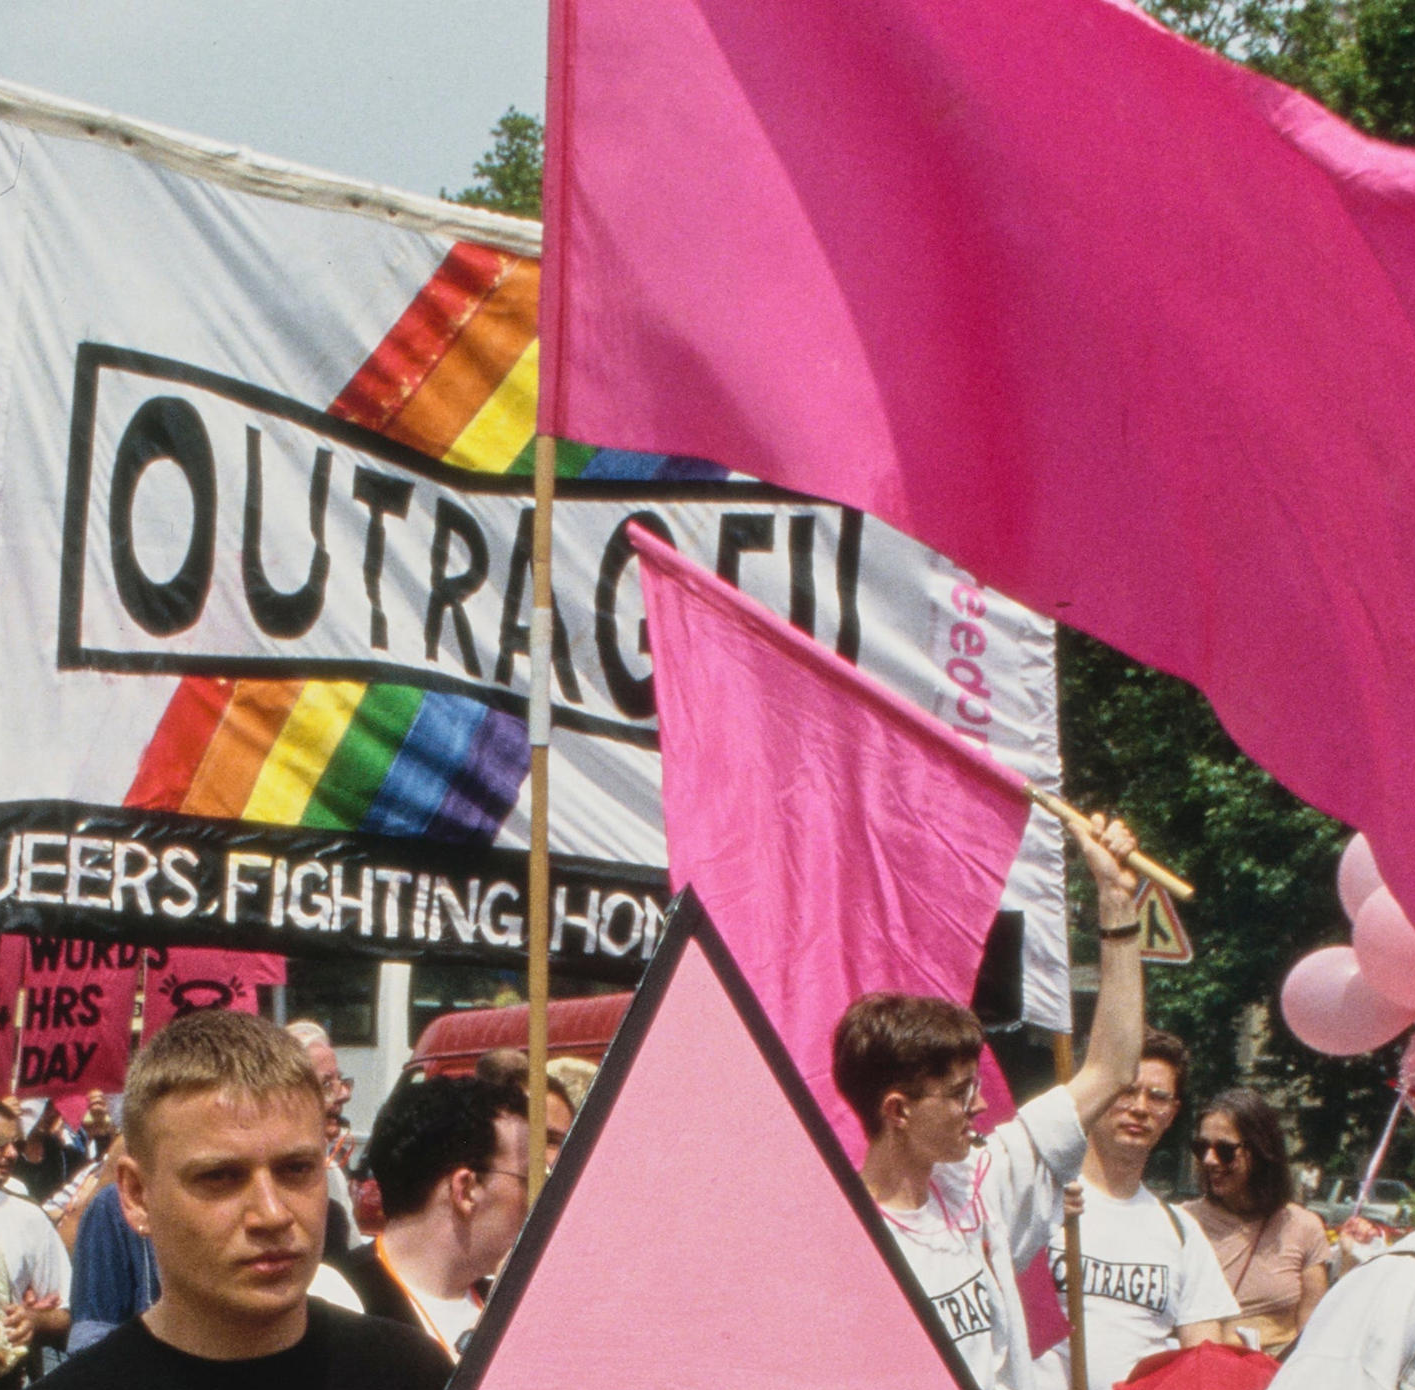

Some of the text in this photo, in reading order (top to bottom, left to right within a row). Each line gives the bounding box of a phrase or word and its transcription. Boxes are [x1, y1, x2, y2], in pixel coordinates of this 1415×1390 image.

[225, 852, 524, 947] FIGHTING
[26, 985, 104, 1031] HRS
[18, 1043, 97, 1087] DAY
[1053, 1253, 1167, 1310] OTRAGE!
